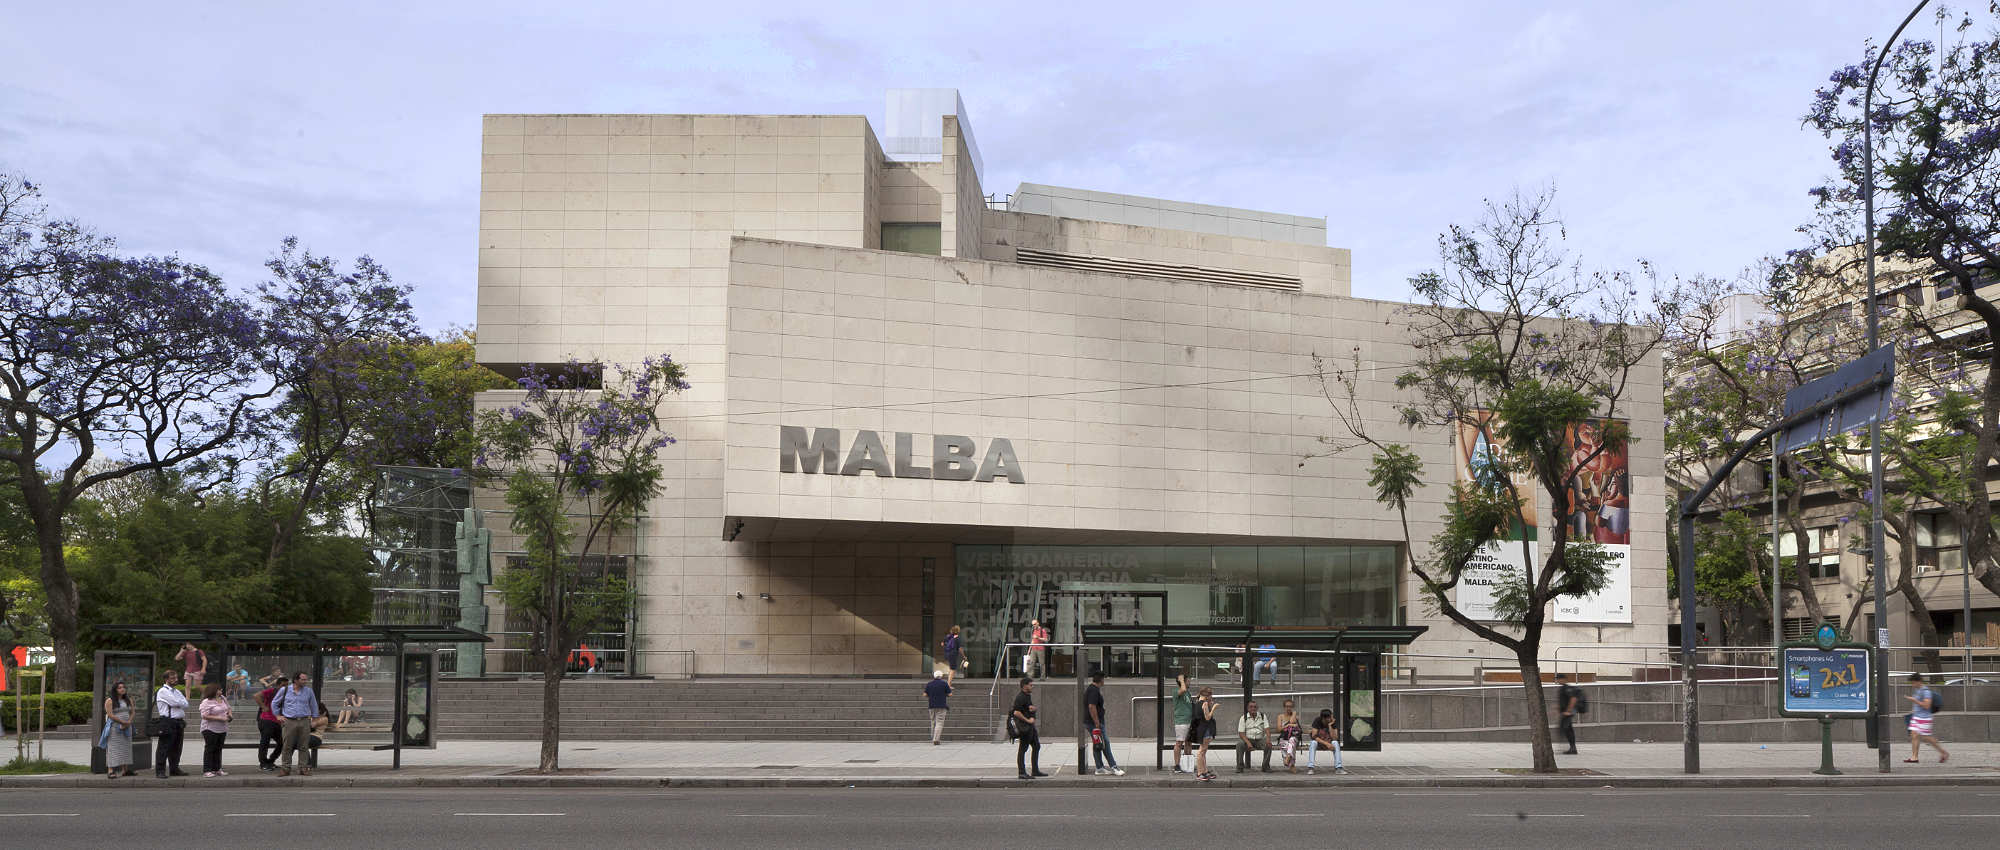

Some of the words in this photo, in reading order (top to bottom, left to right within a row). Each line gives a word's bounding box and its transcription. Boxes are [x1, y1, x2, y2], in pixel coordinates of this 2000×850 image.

[780, 425, 1025, 484] MALBA
[1465, 563, 1513, 571] AMERICANO
[1819, 663, 1860, 689] 2x1
